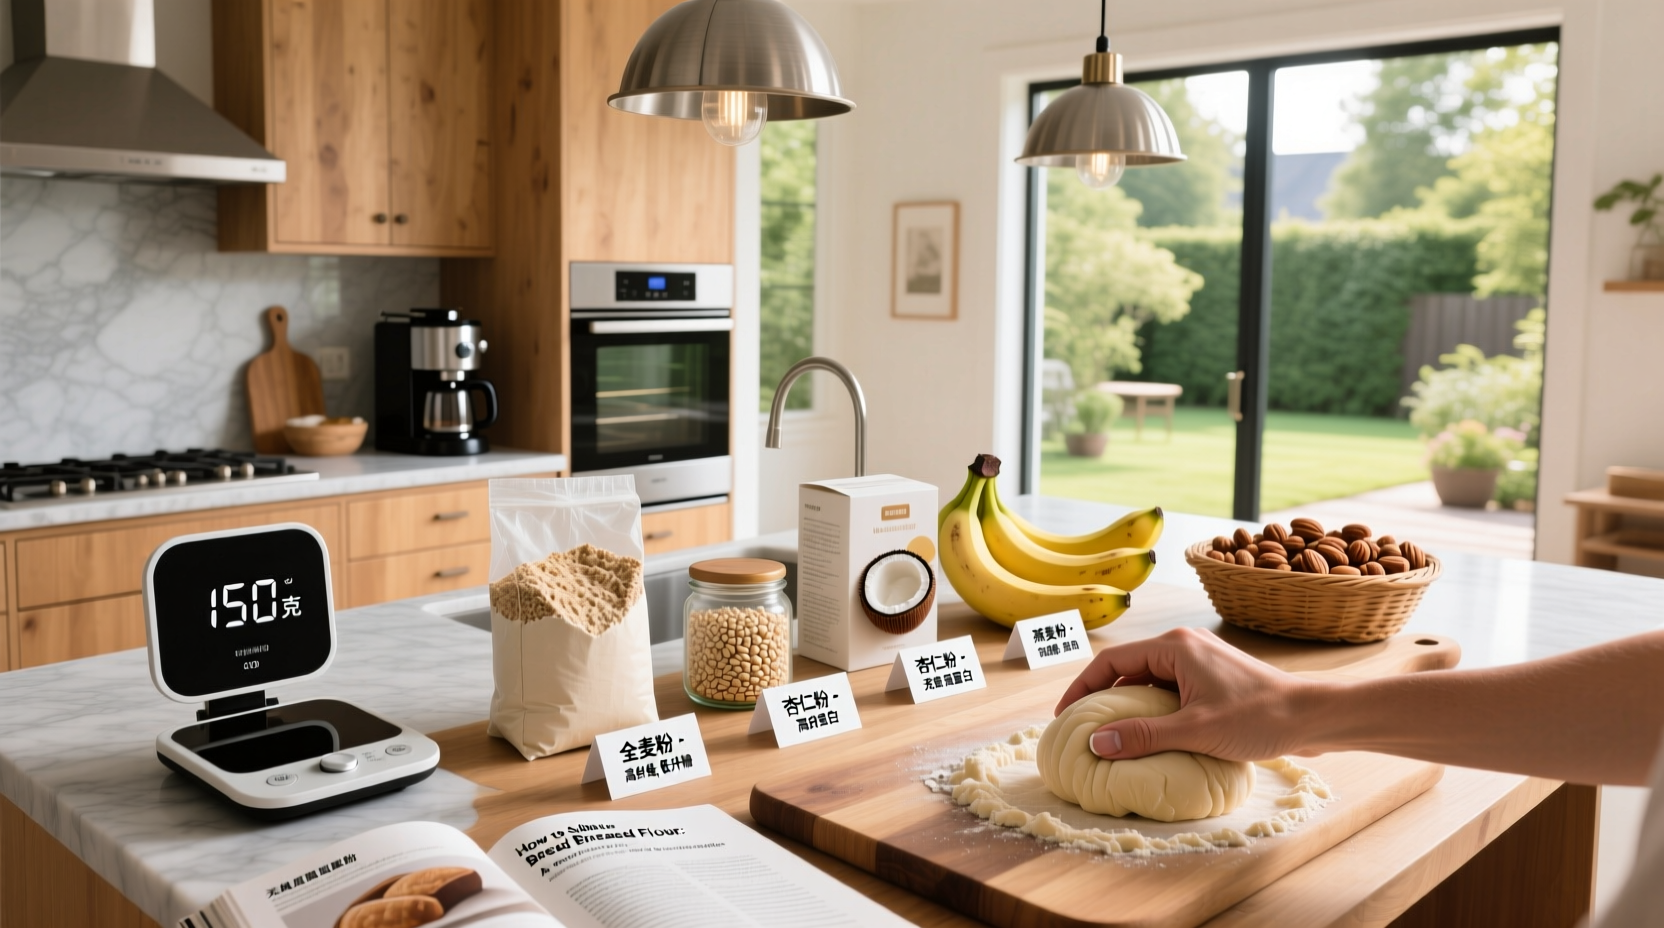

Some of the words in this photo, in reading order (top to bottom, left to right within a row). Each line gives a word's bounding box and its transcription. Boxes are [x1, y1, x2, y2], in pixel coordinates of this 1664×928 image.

[781, 689, 828, 717] 杏仁粉
[619, 732, 673, 763] 全麦粉
